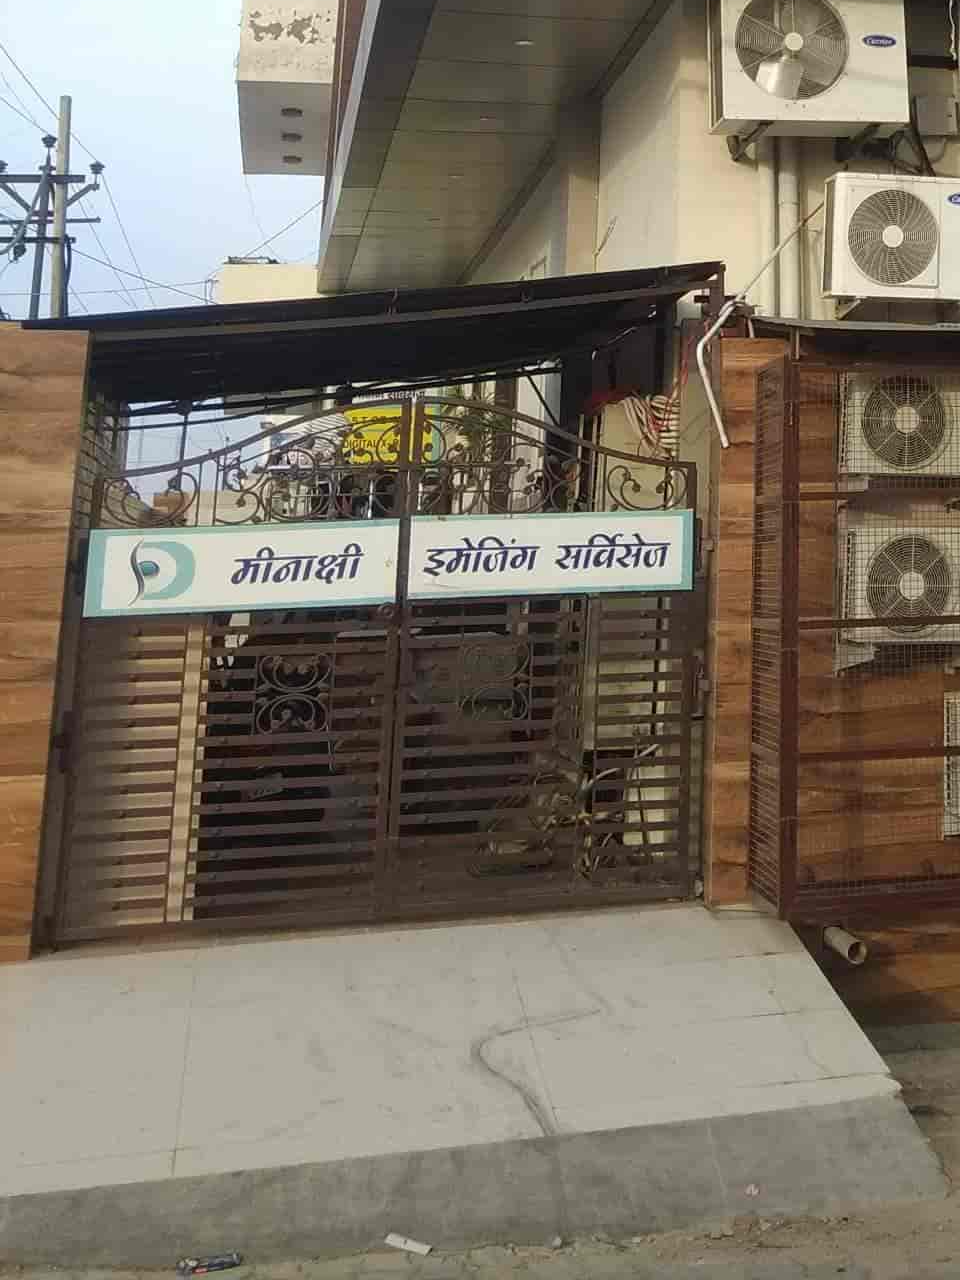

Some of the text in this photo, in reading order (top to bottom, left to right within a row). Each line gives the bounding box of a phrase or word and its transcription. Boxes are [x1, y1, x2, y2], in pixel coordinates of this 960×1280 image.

[230, 532, 671, 585] मीनाक्षी इमेजिंग सर्विसेज
